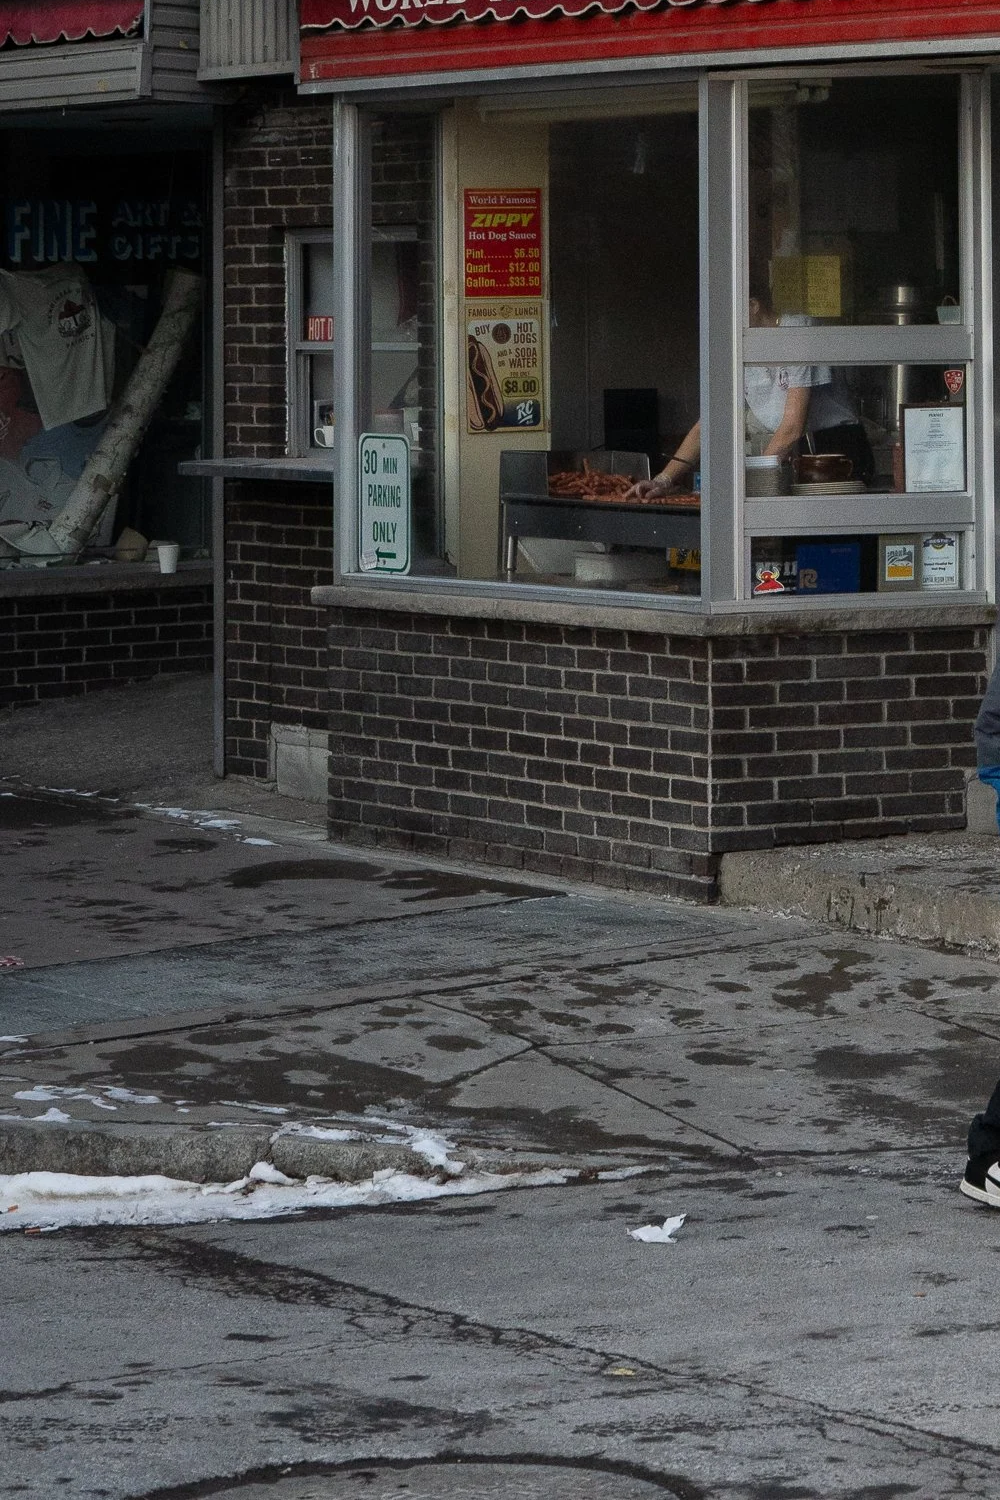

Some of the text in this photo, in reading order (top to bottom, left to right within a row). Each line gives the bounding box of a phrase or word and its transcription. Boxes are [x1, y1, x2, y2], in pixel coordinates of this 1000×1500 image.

[470, 194, 536, 204] World Famous
[471, 213, 534, 227] ZIPPY
[6, 199, 98, 263] FINE
[113, 200, 170, 228] ART
[469, 230, 536, 242] Hot Dog Sauce
[110, 233, 201, 261] GIFTS
[514, 248, 540, 258] $6.50
[468, 307, 538, 317] FAMOUS LUNCH
[308, 317, 325, 340] HOT
[475, 324, 490, 336] BUY
[516, 322, 533, 333] HOT
[513, 333, 537, 344] DOGS
[515, 347, 537, 358] SODA
[508, 357, 537, 368] WATER
[516, 400, 533, 420] RC
[364, 450, 398, 474] 30 MIN
[368, 484, 401, 507] PARKING
[373, 521, 397, 543] ONLY
